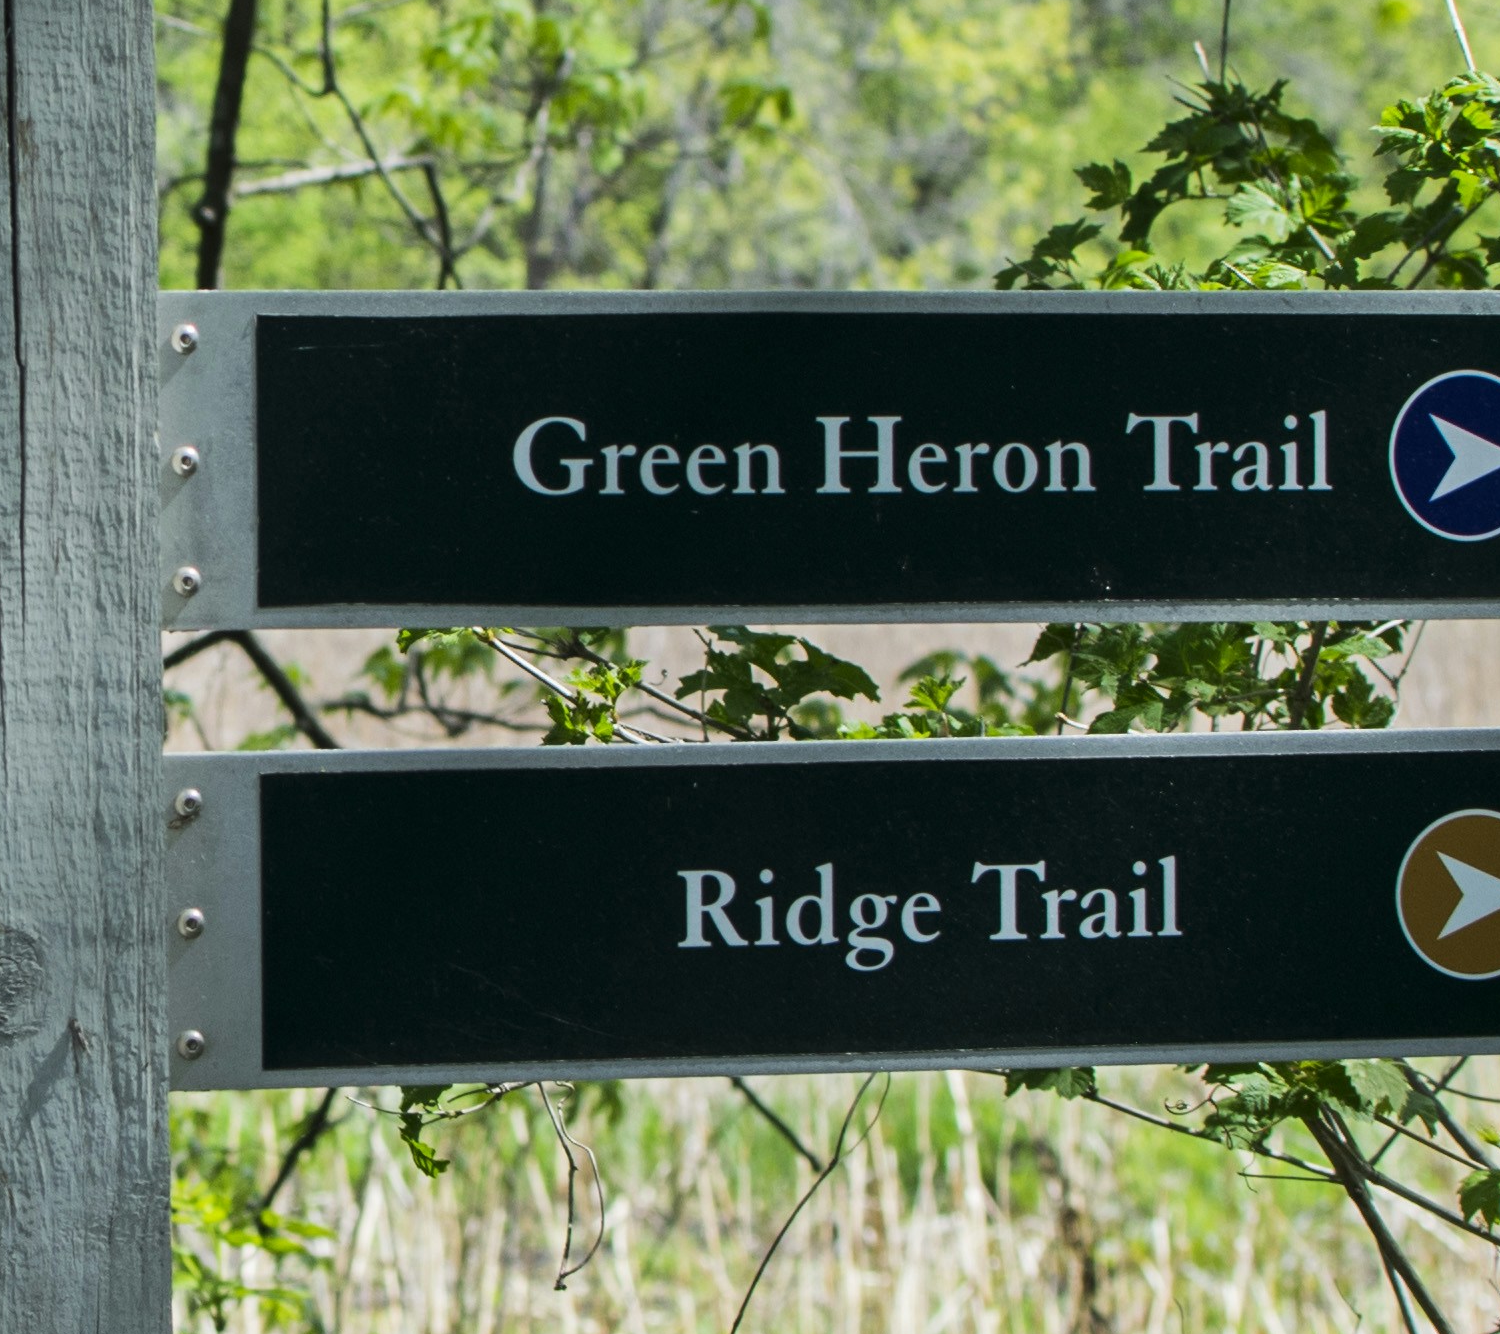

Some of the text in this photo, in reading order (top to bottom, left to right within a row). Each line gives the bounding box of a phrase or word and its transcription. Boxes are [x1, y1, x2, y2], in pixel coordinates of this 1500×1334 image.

[512, 408, 1334, 496] Green Heron Trail
[676, 854, 1184, 972] Ridge Trail
